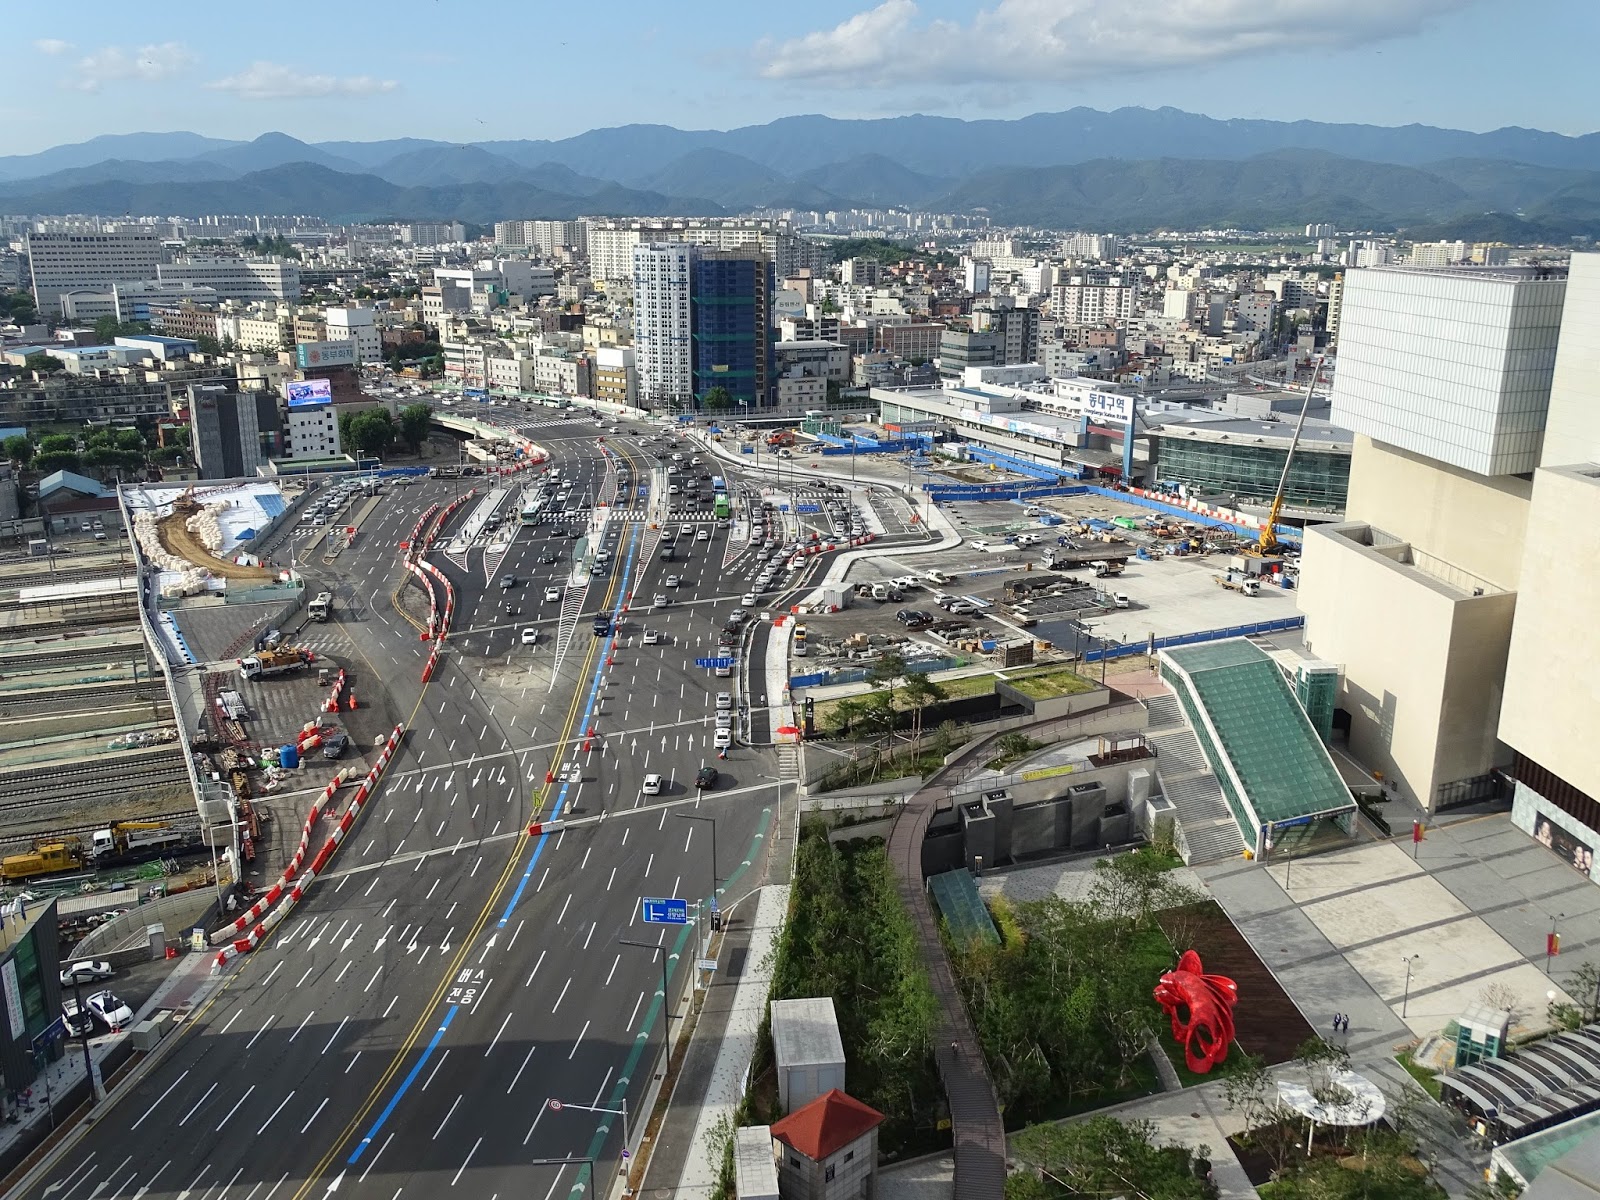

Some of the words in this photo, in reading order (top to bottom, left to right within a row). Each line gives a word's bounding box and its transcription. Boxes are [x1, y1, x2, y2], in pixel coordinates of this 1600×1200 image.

[321, 349, 354, 360] 동부화재
[1089, 393, 1125, 413] 동대구역
[562, 763, 581, 771] 버스
[457, 969, 485, 984] 버스
[446, 988, 477, 1004] 전용
